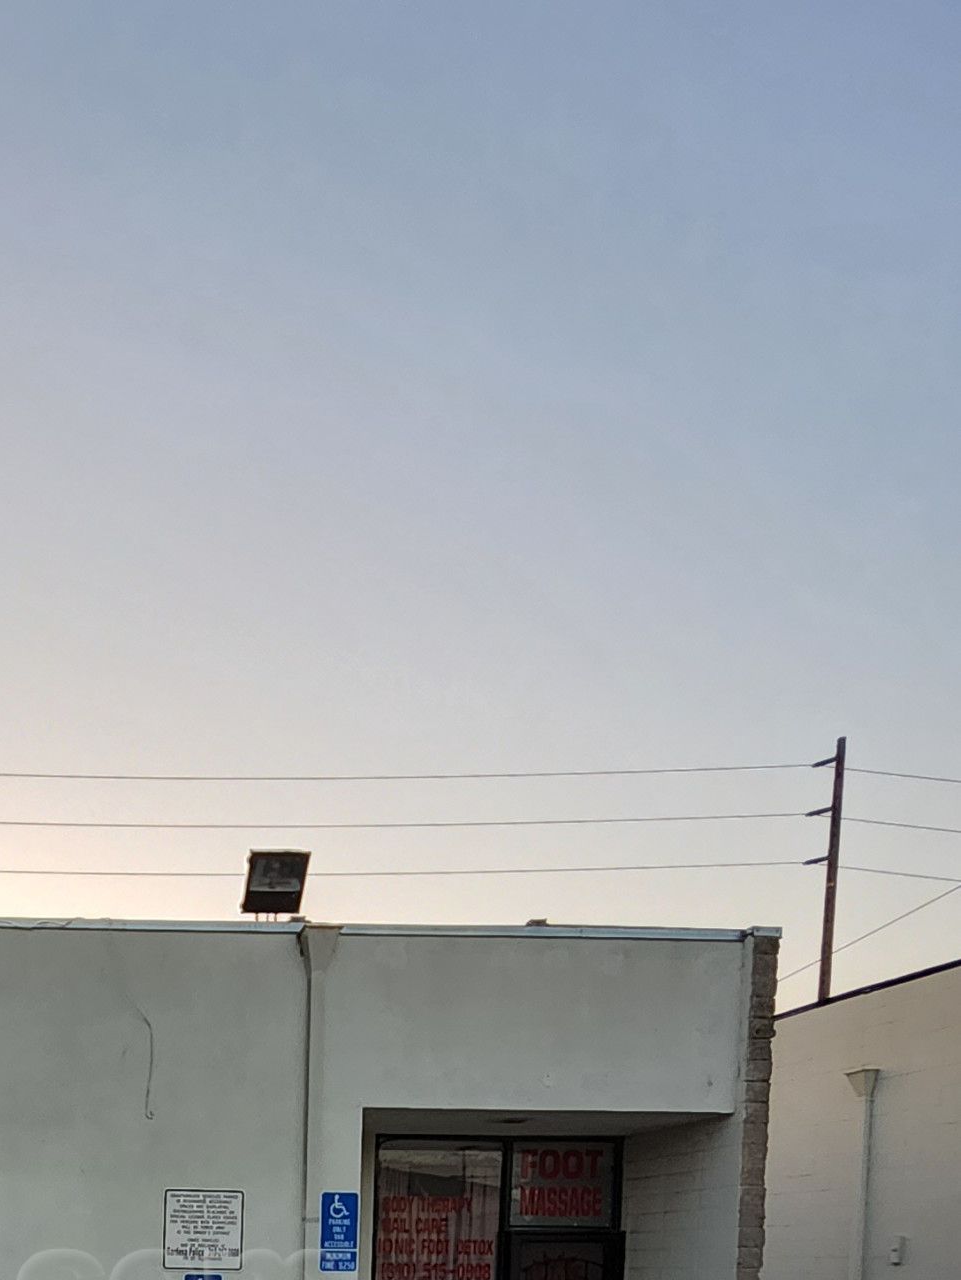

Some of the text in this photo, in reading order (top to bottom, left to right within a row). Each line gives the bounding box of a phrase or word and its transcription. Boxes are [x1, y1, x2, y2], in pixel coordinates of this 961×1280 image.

[521, 1149, 603, 1179] FOOT
[382, 1196, 473, 1214] BODY THERAPY
[520, 1186, 603, 1217] MASSAGE
[415, 1218, 448, 1234] CARE
[378, 1238, 494, 1256] IONIC FOOT DETOX
